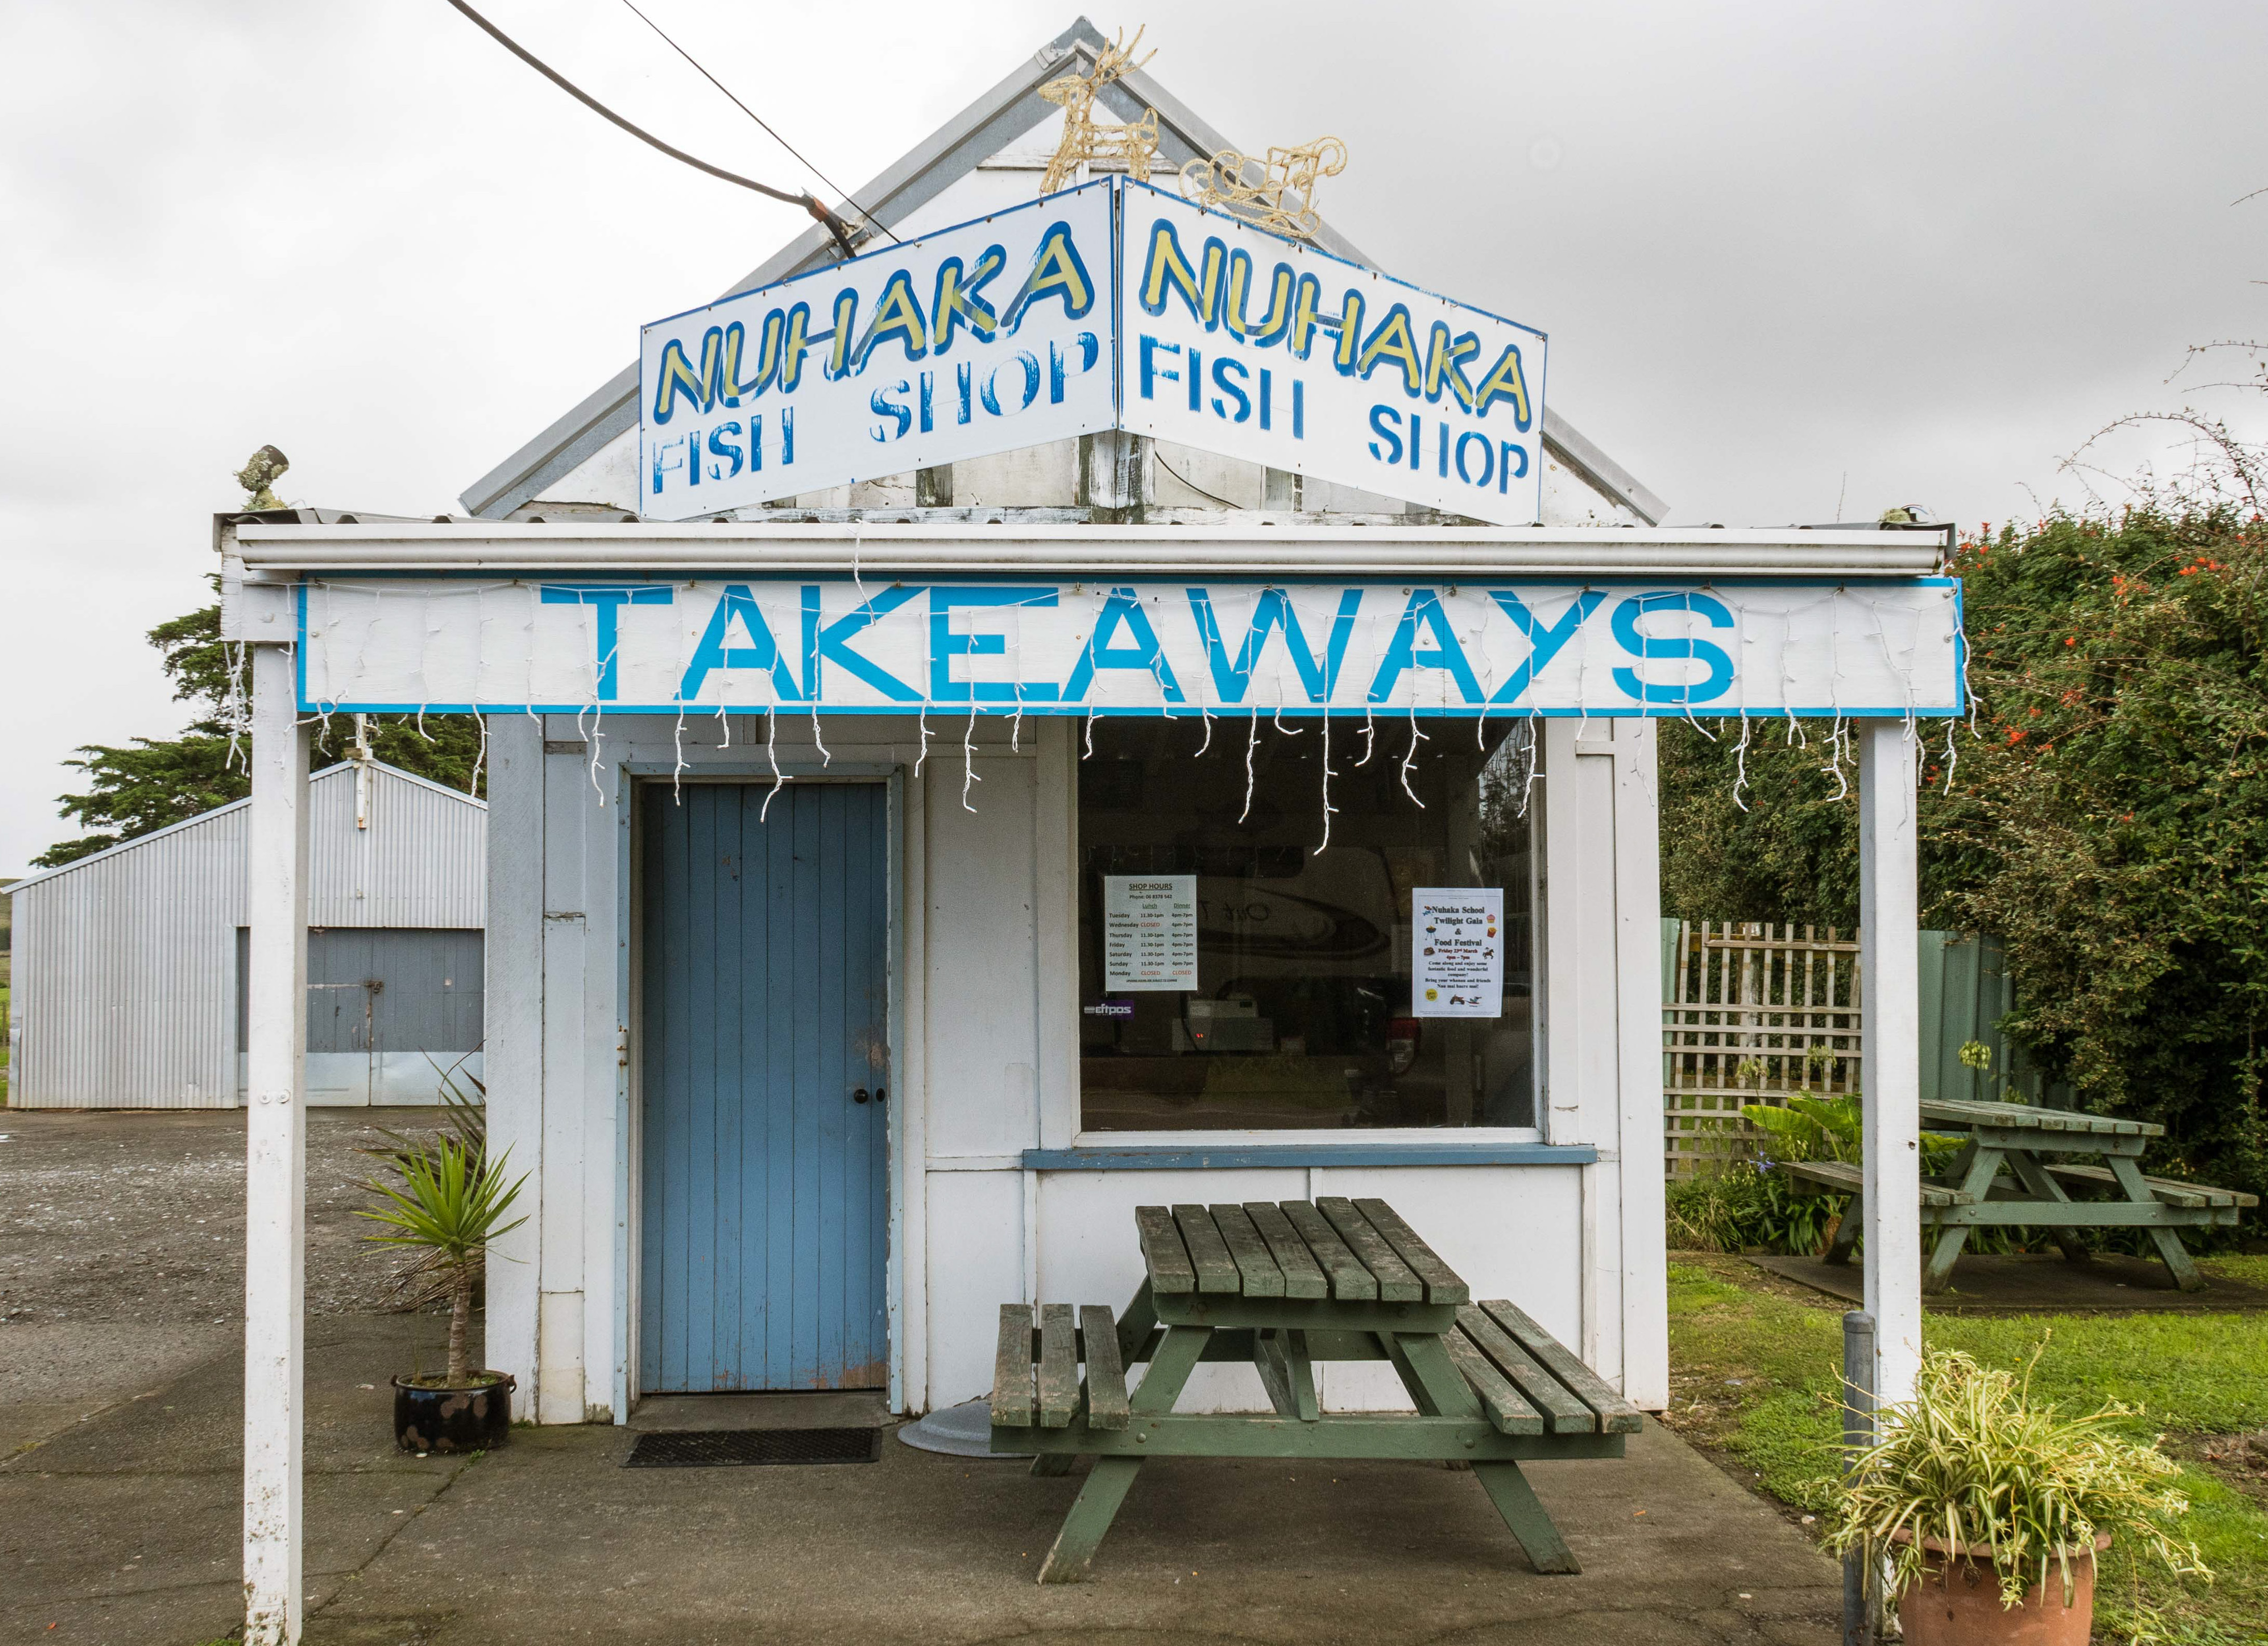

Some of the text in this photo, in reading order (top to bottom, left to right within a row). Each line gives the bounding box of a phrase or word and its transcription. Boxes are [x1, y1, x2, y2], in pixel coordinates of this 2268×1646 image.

[653, 221, 1095, 425] NUHAKA
[1139, 218, 1532, 433] NUHAKA
[653, 331, 1099, 494] FISH SHOP
[1140, 333, 1529, 494] FISH SHOP
[541, 584, 1734, 704] TAKEAWAYS
[1434, 917, 1463, 926] Twilight
[1095, 1003, 1131, 1015] eftpos
